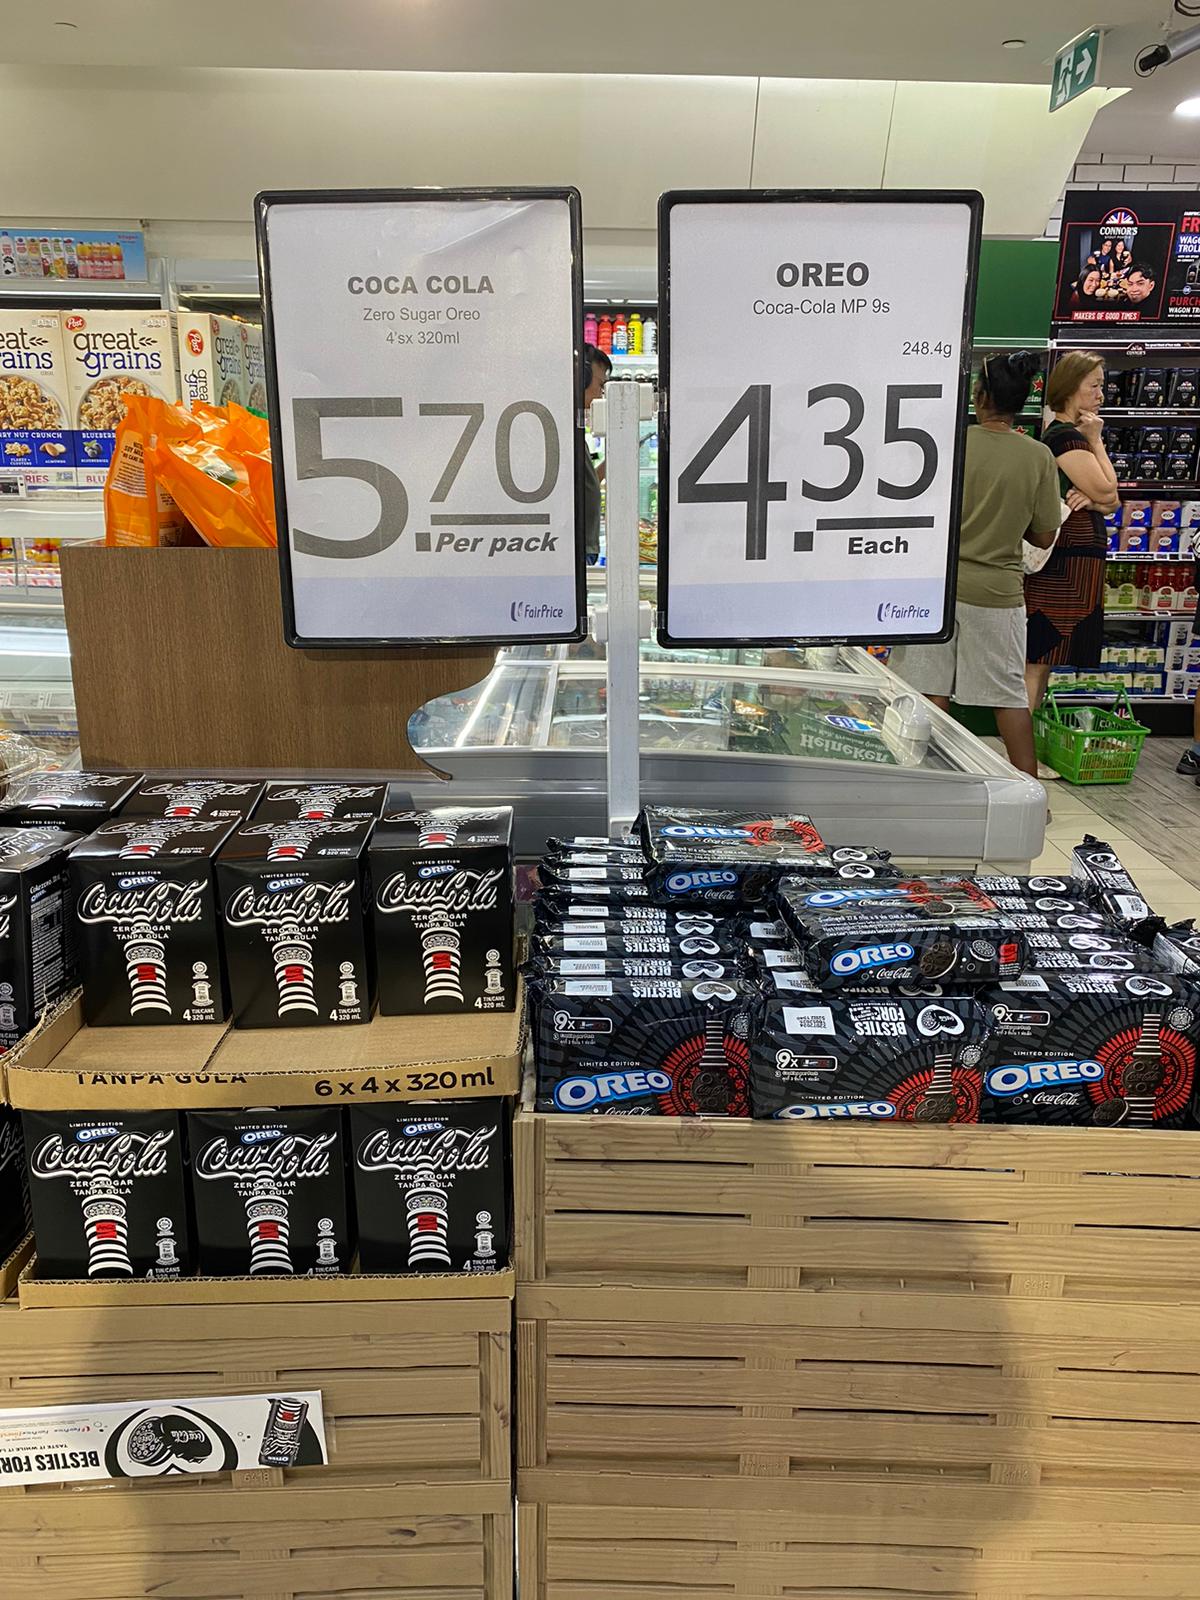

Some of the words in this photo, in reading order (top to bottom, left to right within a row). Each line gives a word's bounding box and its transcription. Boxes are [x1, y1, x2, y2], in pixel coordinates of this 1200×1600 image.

[1099, 226, 1138, 236] CONNOR'S
[776, 261, 870, 288] OREO
[348, 276, 418, 294] COCA
[426, 276, 494, 294] COLA
[753, 298, 836, 314] Coca-Cola
[841, 299, 867, 314] MP
[872, 298, 890, 314] 9s
[67, 316, 83, 329] Post
[363, 308, 395, 321] Zero
[400, 308, 442, 325] Sugar
[446, 307, 480, 320] Oreo
[1074, 312, 1096, 320] MAKERS
[1097, 312, 1104, 320] OF
[1105, 312, 1120, 320] GOOD
[1122, 312, 1138, 320] TIMES
[74, 328, 140, 361] great
[189, 333, 202, 353] Post
[386, 331, 413, 344] 4'sx
[418, 331, 460, 344] 320ml
[902, 341, 952, 358] 248.4g
[0, 350, 53, 370] ains
[84, 350, 162, 378] grains
[435, 532, 482, 554] Per
[488, 532, 560, 558] pack
[848, 536, 909, 555] Each
[524, 604, 563, 619] FairPrice
[890, 604, 930, 619] FairPrice
[665, 826, 753, 838] OREO
[420, 864, 457, 877] OREO
[120, 876, 158, 889] OREO
[269, 878, 306, 891] OREO
[667, 870, 737, 892] OREO
[376, 868, 504, 912] Coca-Cola
[704, 890, 736, 900] Coca-Cola
[77, 880, 208, 925] Coca-Cola
[225, 880, 355, 926] Coca-Cola
[808, 890, 909, 905] OREO
[410, 914, 434, 922] ZERO
[146, 932, 169, 940] GULA
[623, 926, 666, 934] BESTIES
[625, 942, 670, 953] BESTIES
[834, 944, 913, 972] OREO
[624, 966, 672, 976] BESTIES
[876, 968, 912, 980] Coca-Cola
[633, 987, 682, 998] BESTIES
[1068, 984, 1118, 994] BESTIES
[474, 997, 483, 1008] 4
[182, 1009, 192, 1020] 4
[330, 1009, 338, 1021] 4
[854, 1021, 908, 1036] BESTIES
[314, 1080, 333, 1097] 6
[338, 1082, 356, 1096] x
[361, 1076, 379, 1094] 4
[384, 1079, 402, 1093] x
[406, 1071, 457, 1091] 320
[462, 1066, 494, 1088] ml
[990, 1062, 1102, 1092] OREO
[558, 1073, 671, 1106] OREO
[1032, 1092, 1080, 1106] Coca-Cola
[779, 1104, 895, 1119] OREO
[78, 1127, 118, 1141] OREO
[406, 1122, 444, 1136] OREO
[244, 1130, 283, 1144] OREO
[31, 1129, 174, 1180] Coca-Cola
[195, 1131, 338, 1180] Coca-Cola
[357, 1125, 497, 1172] Coca-Cola
[70, 1180, 96, 1188] ZERO
[263, 1180, 296, 1188] SUGAR
[74, 1188, 103, 1196] TANPA
[463, 1260, 472, 1271] 4
[170, 1430, 206, 1444] Coca-Cola
[0, 1455, 32, 1474] FOR
[35, 1450, 100, 1471] BESTIES
